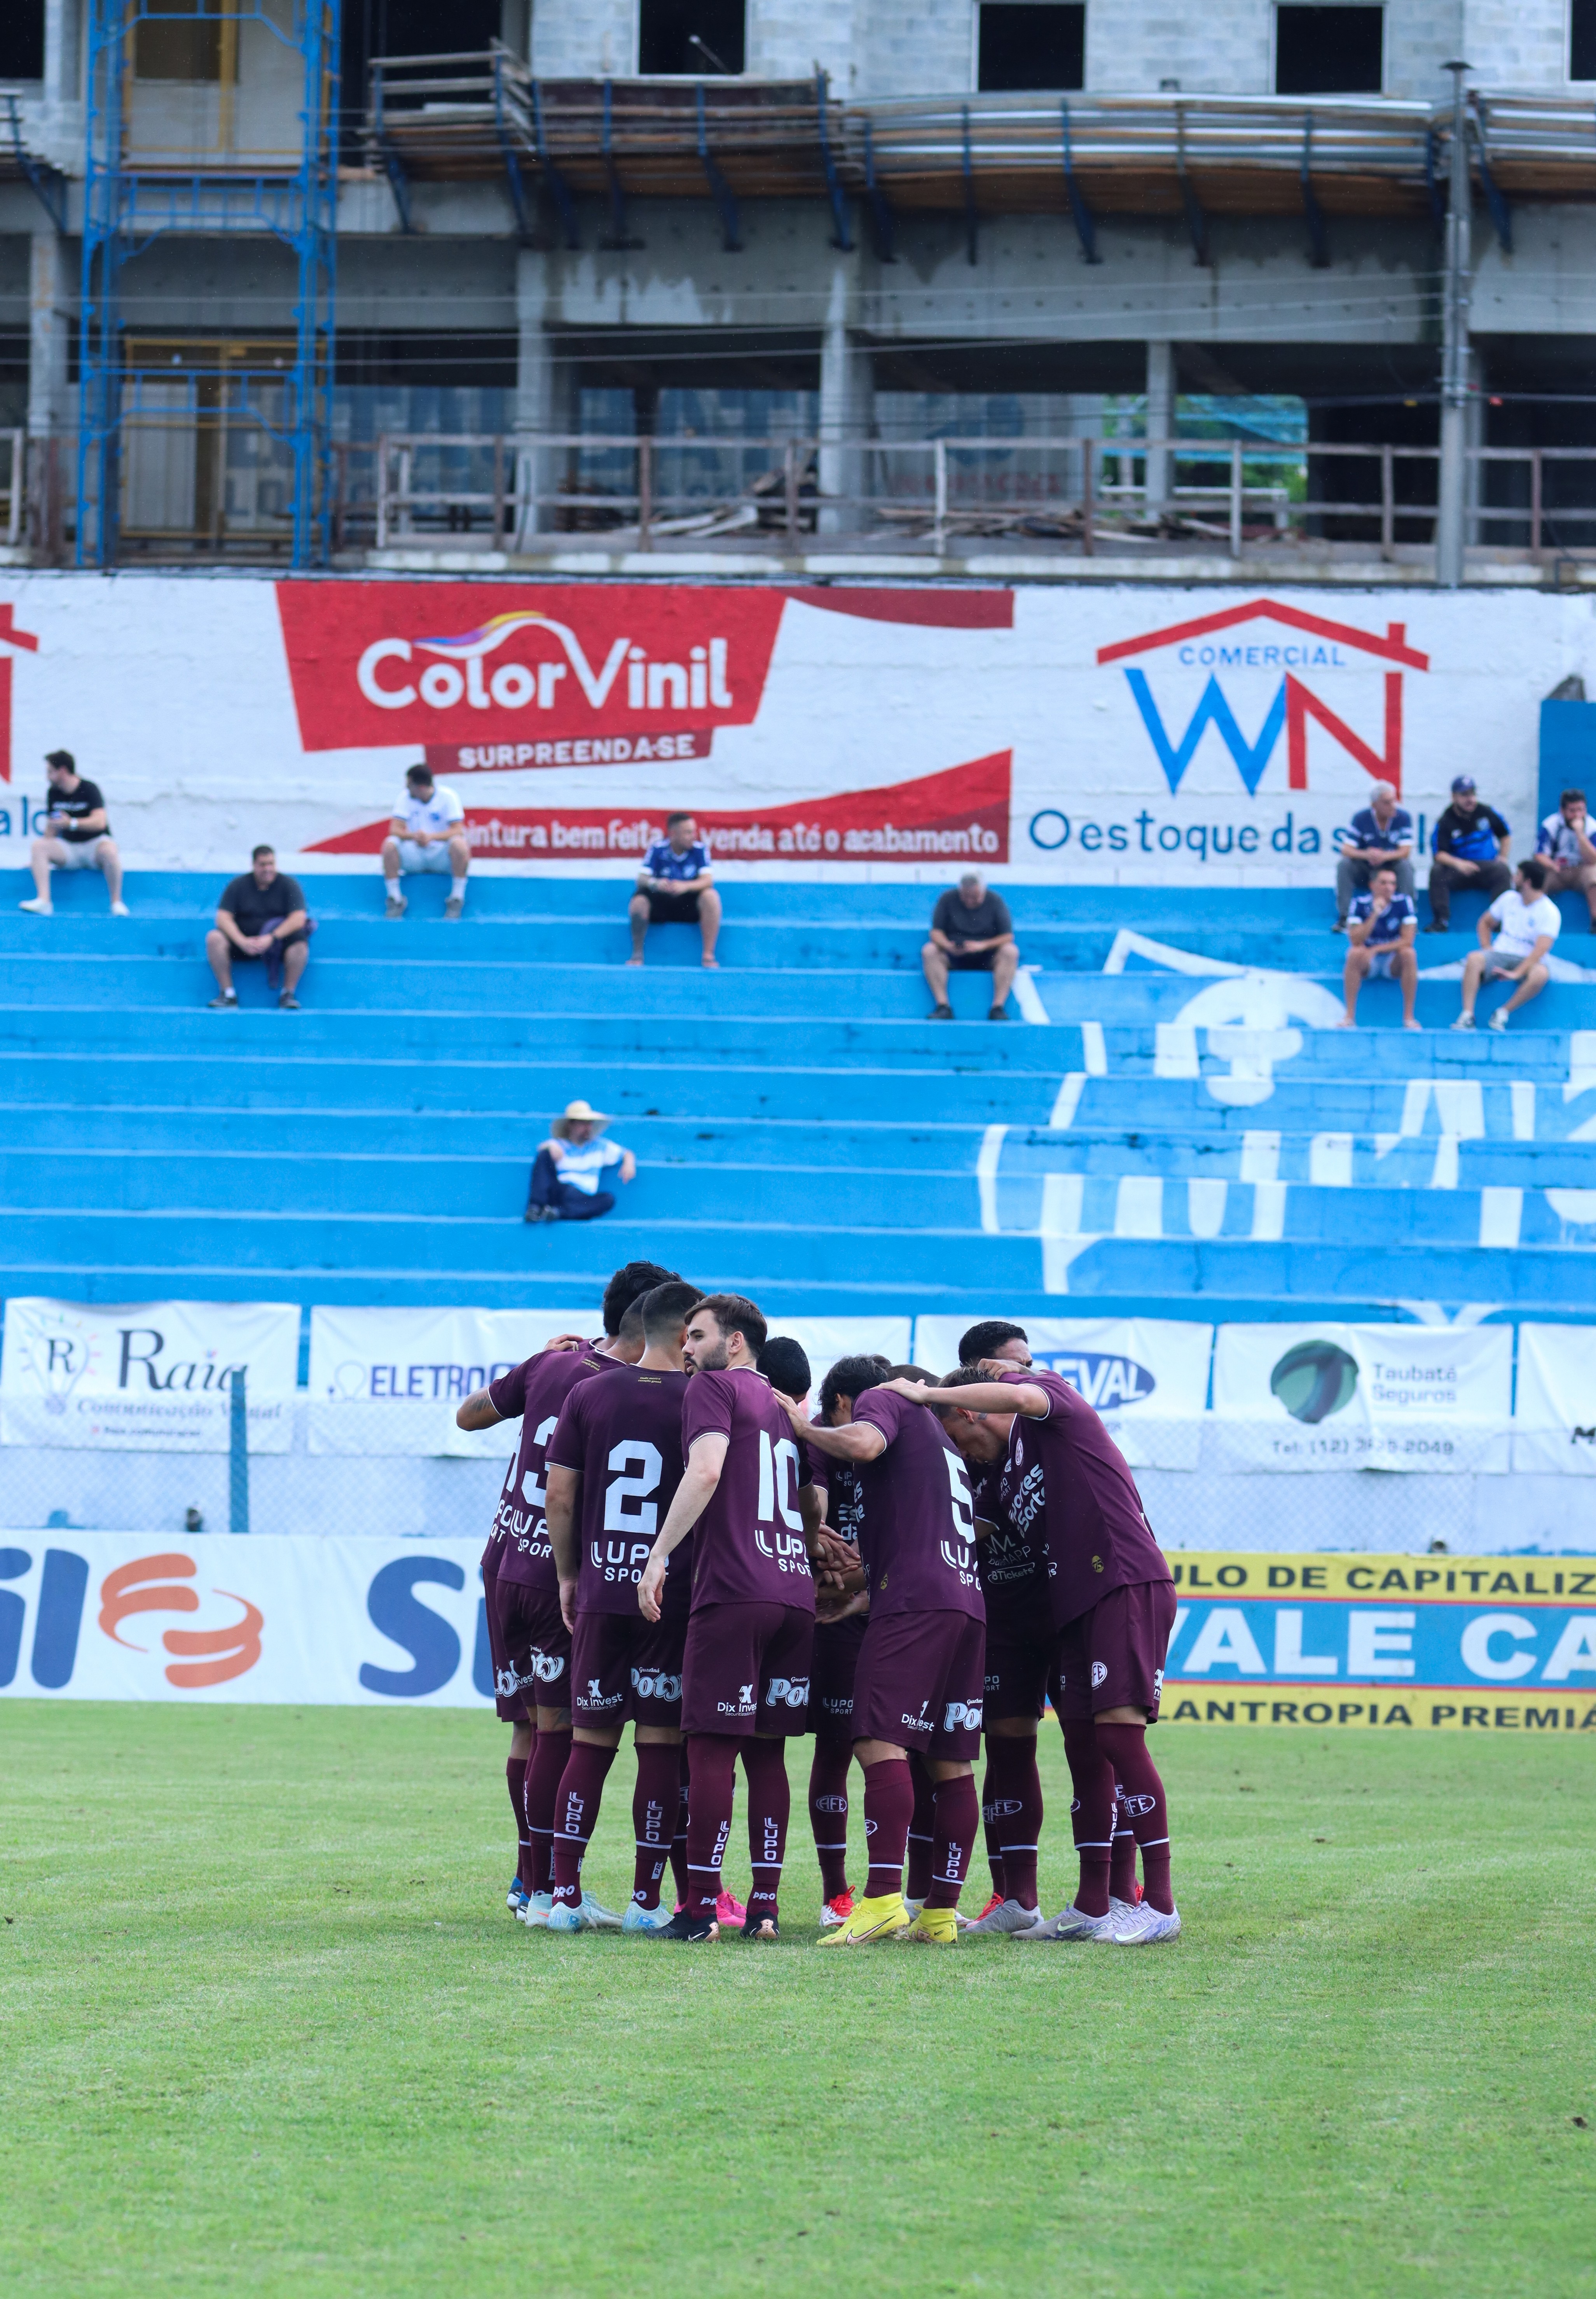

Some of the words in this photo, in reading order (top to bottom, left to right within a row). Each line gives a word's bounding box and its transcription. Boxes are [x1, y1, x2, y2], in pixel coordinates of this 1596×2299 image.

[1178, 644, 1346, 666] COMERCIAL
[1123, 669, 1404, 802] WN
[464, 818, 548, 848] intura
[551, 820, 606, 849] bem
[608, 818, 664, 850] feita
[778, 822, 821, 852] até
[823, 830, 840, 851] o
[843, 822, 999, 854] acabamento
[1080, 809, 1259, 861] estoque
[1271, 812, 1321, 853] da
[47, 1338, 75, 1374] R
[1373, 1363, 1457, 1382] Taubaté
[1373, 1384, 1456, 1405] Seguros
[604, 1439, 663, 1535] 2
[758, 1429, 804, 1532] 10
[942, 1446, 976, 1544] 5
[1268, 1566, 1327, 1589] DE
[577, 1696, 588, 1706] Dix
[590, 1693, 623, 1707] Invest
[717, 1702, 736, 1712] Dix
[901, 1713, 917, 1726] Dix
[565, 1791, 585, 1834] LUPO
[819, 1797, 843, 1810] AFE
[645, 1800, 663, 1842] LUPO
[711, 1820, 730, 1865] LUPO
[764, 1817, 778, 1861] LUPO
[946, 1842, 962, 1878] LUPO
[553, 1885, 575, 1898] PRO
[700, 1897, 717, 1905] PR
[753, 1891, 776, 1900] PRO
